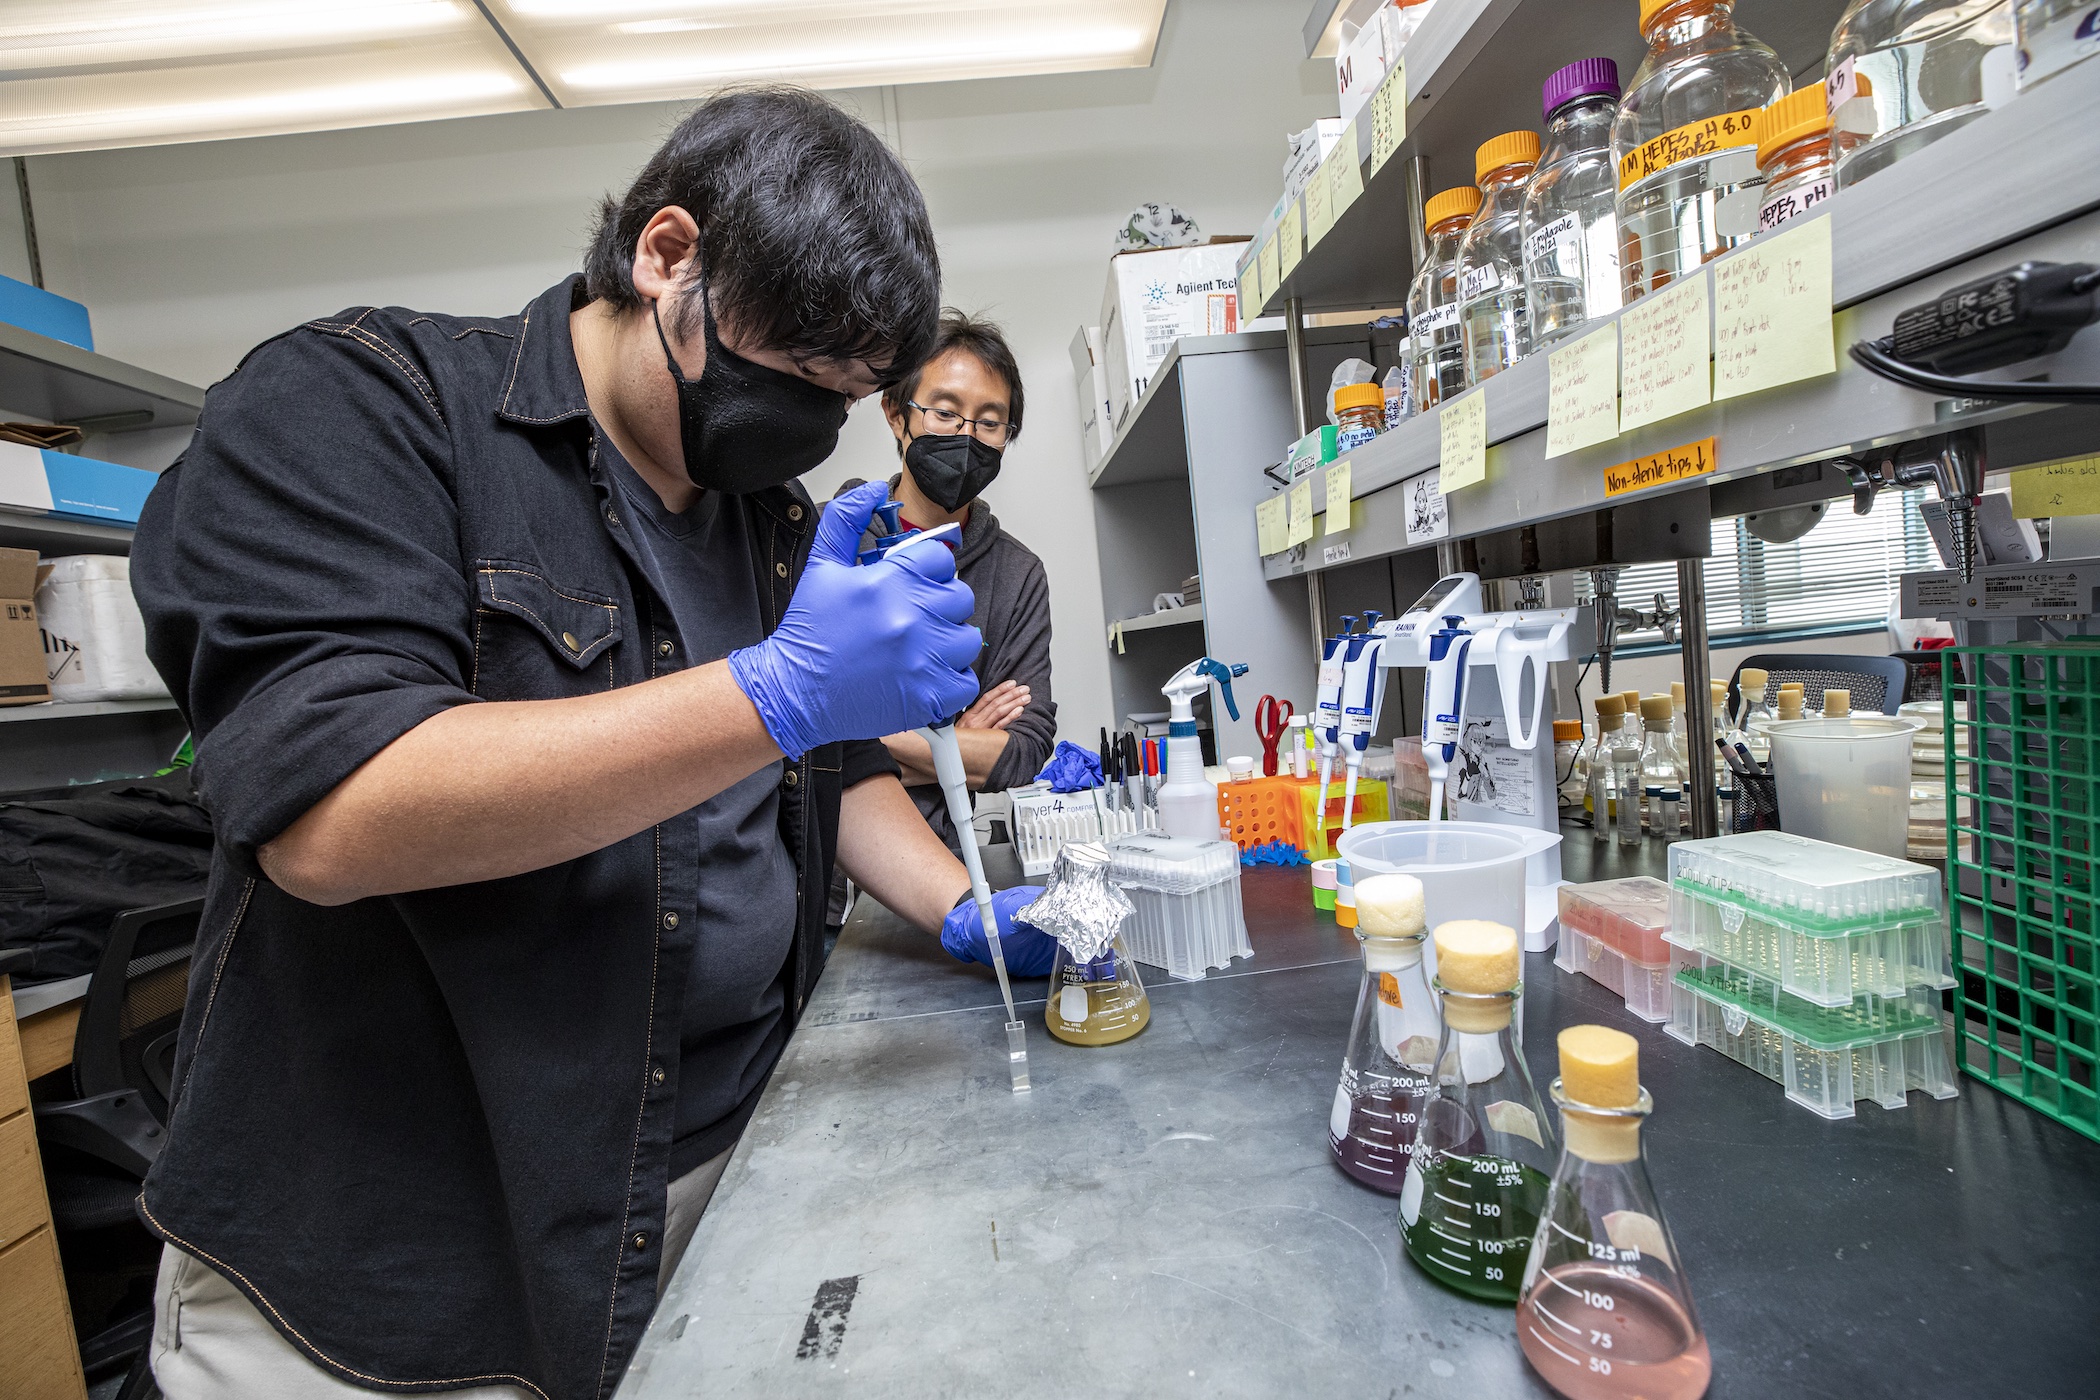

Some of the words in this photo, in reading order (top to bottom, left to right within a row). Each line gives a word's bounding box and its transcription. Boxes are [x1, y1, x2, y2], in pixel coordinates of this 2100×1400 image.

[1642, 131, 1690, 162] HEPES
[1696, 121, 1718, 145] pH
[1722, 114, 1752, 136] 8.0
[1149, 205, 1160, 216] 12
[1759, 195, 1796, 227] HEPES
[1805, 184, 1827, 209] pH
[1132, 213, 1142, 223] 11
[1119, 228, 1132, 239] 10
[1184, 220, 1192, 232] 2
[1532, 217, 1575, 245] Imidazole
[1467, 271, 1489, 289] NaCl
[1176, 280, 1214, 296] Agilent
[1445, 306, 1457, 321] pH
[1607, 459, 1665, 493] Non-sterile
[1666, 453, 1691, 479] tips
[1394, 623, 1417, 632] RAININ
[1706, 875, 1734, 893] xTIP4
[1063, 964, 1076, 974] 250
[1078, 966, 1088, 974] mL
[1119, 980, 1130, 989] 150
[1124, 1000, 1136, 1009] 100
[1131, 1013, 1139, 1023] 50
[1391, 1076, 1414, 1088] 200
[1415, 1076, 1430, 1088] mL
[1395, 1112, 1417, 1124] 150
[1472, 1160, 1499, 1174] 200
[1501, 1161, 1520, 1174] mL
[1475, 1202, 1501, 1218] 150
[1477, 1239, 1504, 1255] 100
[1586, 1241, 1617, 1262] 125
[1485, 1267, 1504, 1281] 50
[1583, 1289, 1615, 1312] 100
[1589, 1329, 1613, 1350] 75
[1588, 1356, 1612, 1376] 50
